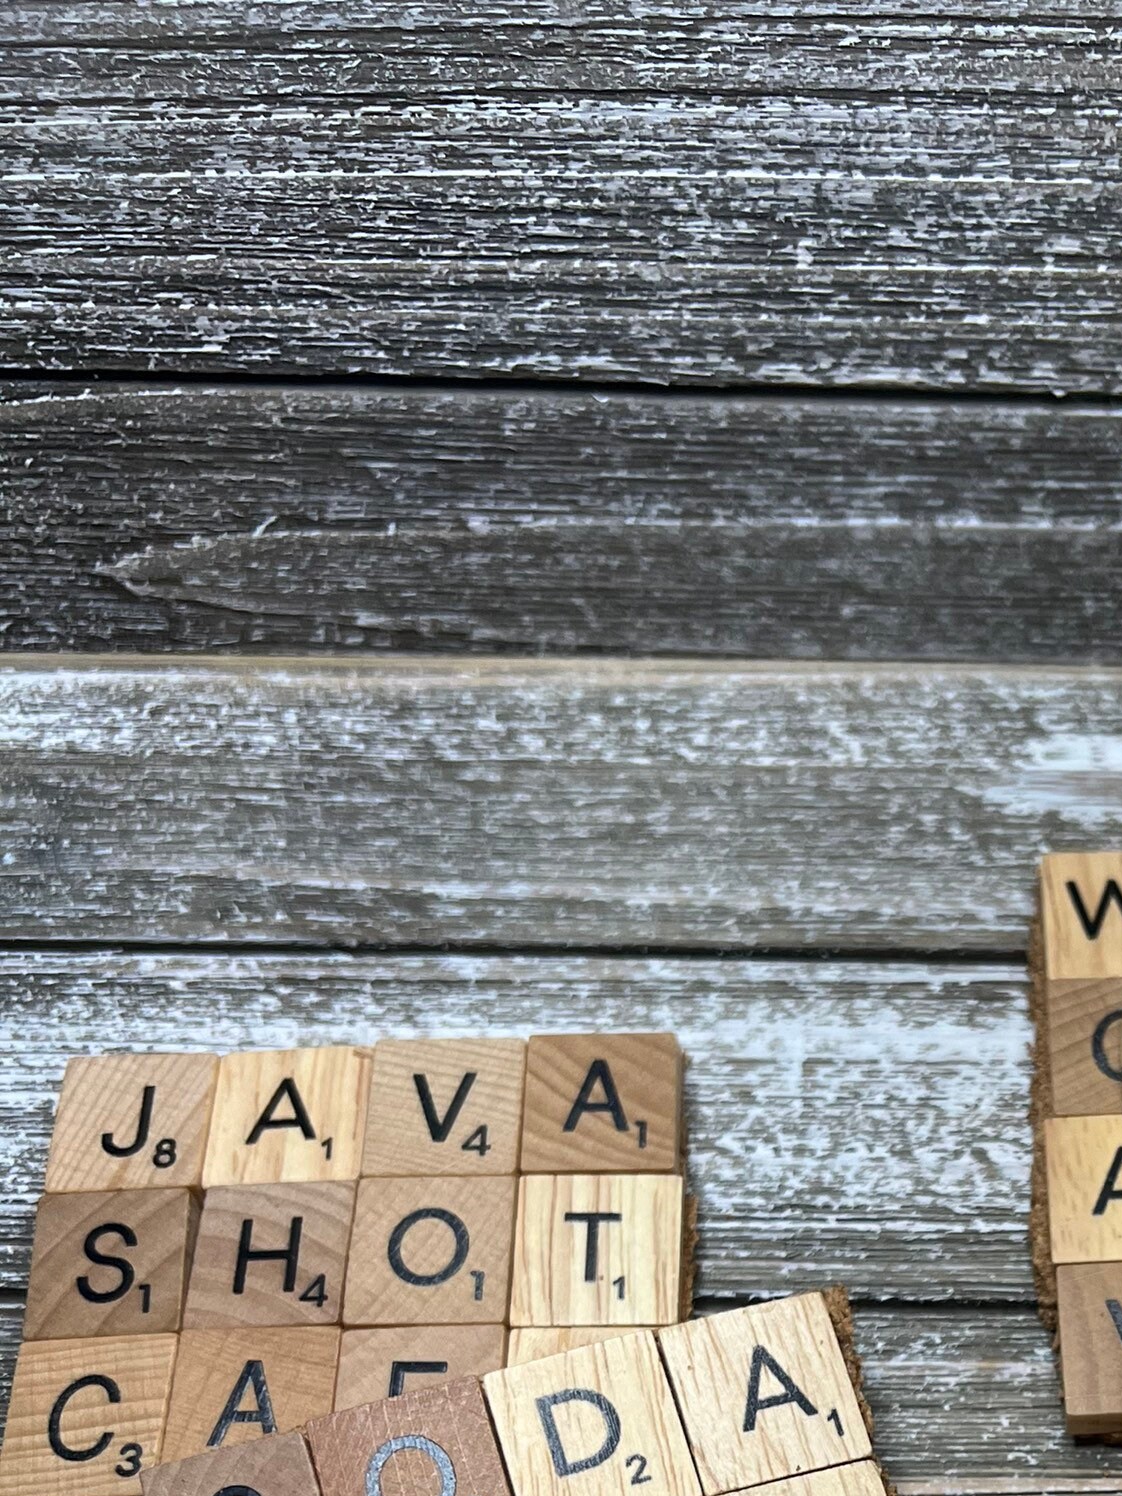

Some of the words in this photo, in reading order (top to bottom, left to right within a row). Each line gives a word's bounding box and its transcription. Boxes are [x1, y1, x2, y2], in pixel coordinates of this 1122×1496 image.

[101, 1059, 628, 1157] JAVA
[152, 1139, 177, 1169] 8
[321, 1136, 333, 1160] 1
[461, 1125, 491, 1157] 4
[635, 1121, 648, 1148] 1
[76, 1208, 621, 1304] SHOT
[138, 1284, 152, 1314] 1
[299, 1273, 328, 1308] 4
[470, 1270, 484, 1300] 1
[612, 1275, 625, 1299] 1
[115, 1443, 143, 1477] 3
[627, 1455, 652, 1484] 2
[827, 1409, 845, 1436] 1
